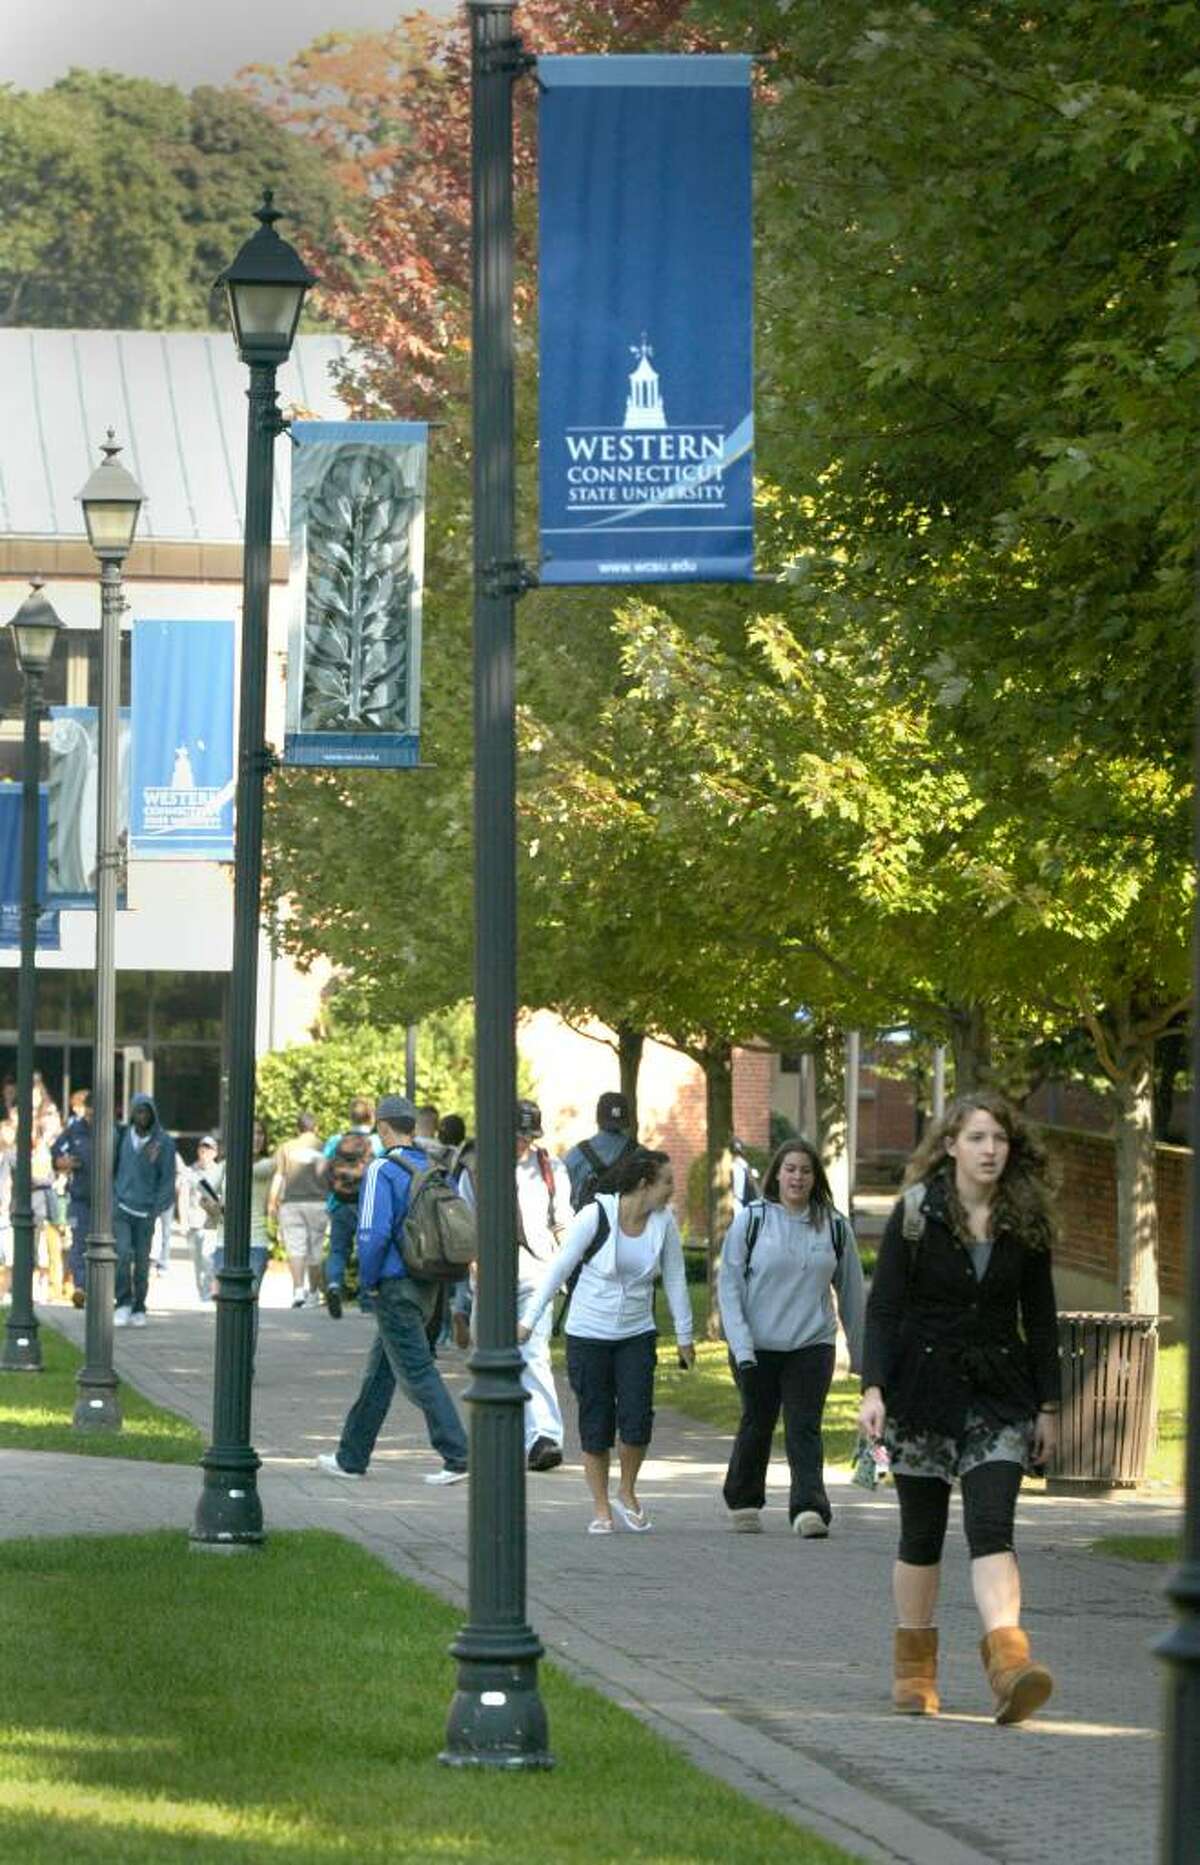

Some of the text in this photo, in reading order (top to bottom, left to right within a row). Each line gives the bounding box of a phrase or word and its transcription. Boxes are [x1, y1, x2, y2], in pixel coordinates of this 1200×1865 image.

[565, 434, 725, 461] WESTERN
[567, 465, 723, 483] CONNECTICUT
[568, 485, 725, 501] STATE UNIVERSITY
